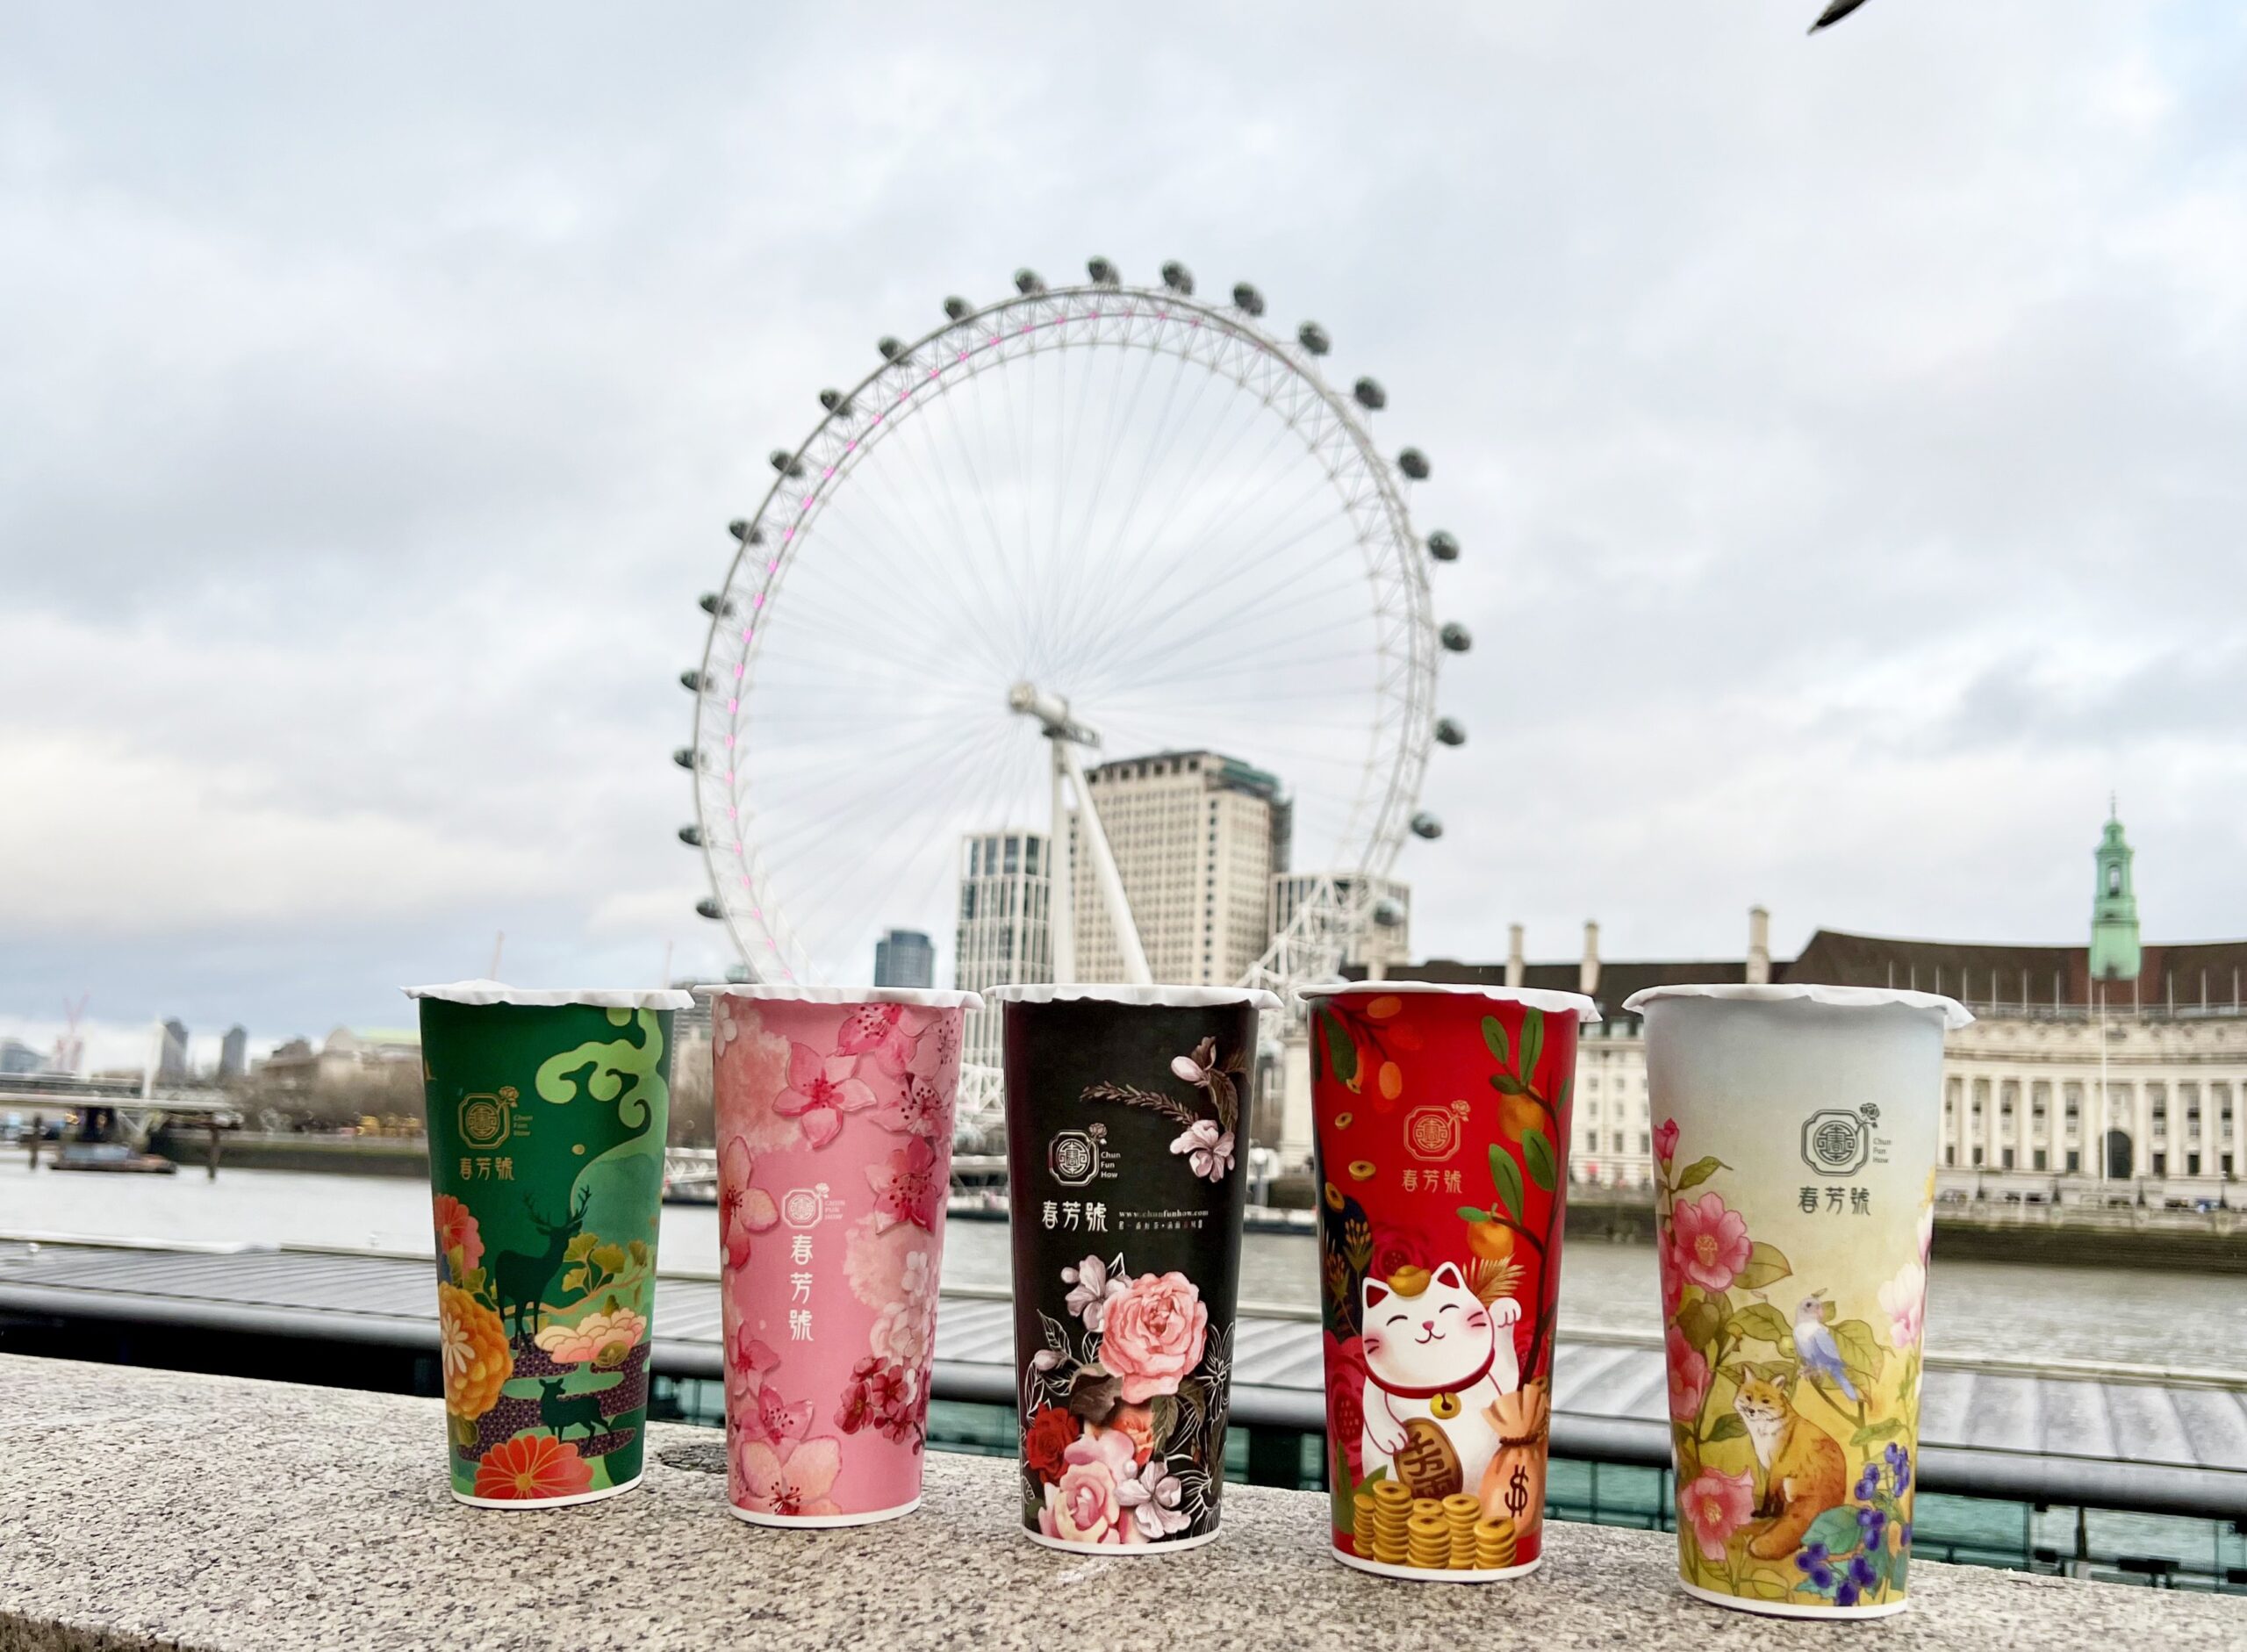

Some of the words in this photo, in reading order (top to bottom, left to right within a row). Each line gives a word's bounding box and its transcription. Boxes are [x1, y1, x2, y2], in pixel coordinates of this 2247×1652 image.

[459, 1157, 515, 1181] 春芳號
[1402, 1168, 1463, 1194] 春芳號
[1042, 1200, 1109, 1232] 春芳號
[1798, 1185, 1870, 1216] 春芳號
[789, 1233, 815, 1341] 春芳號
